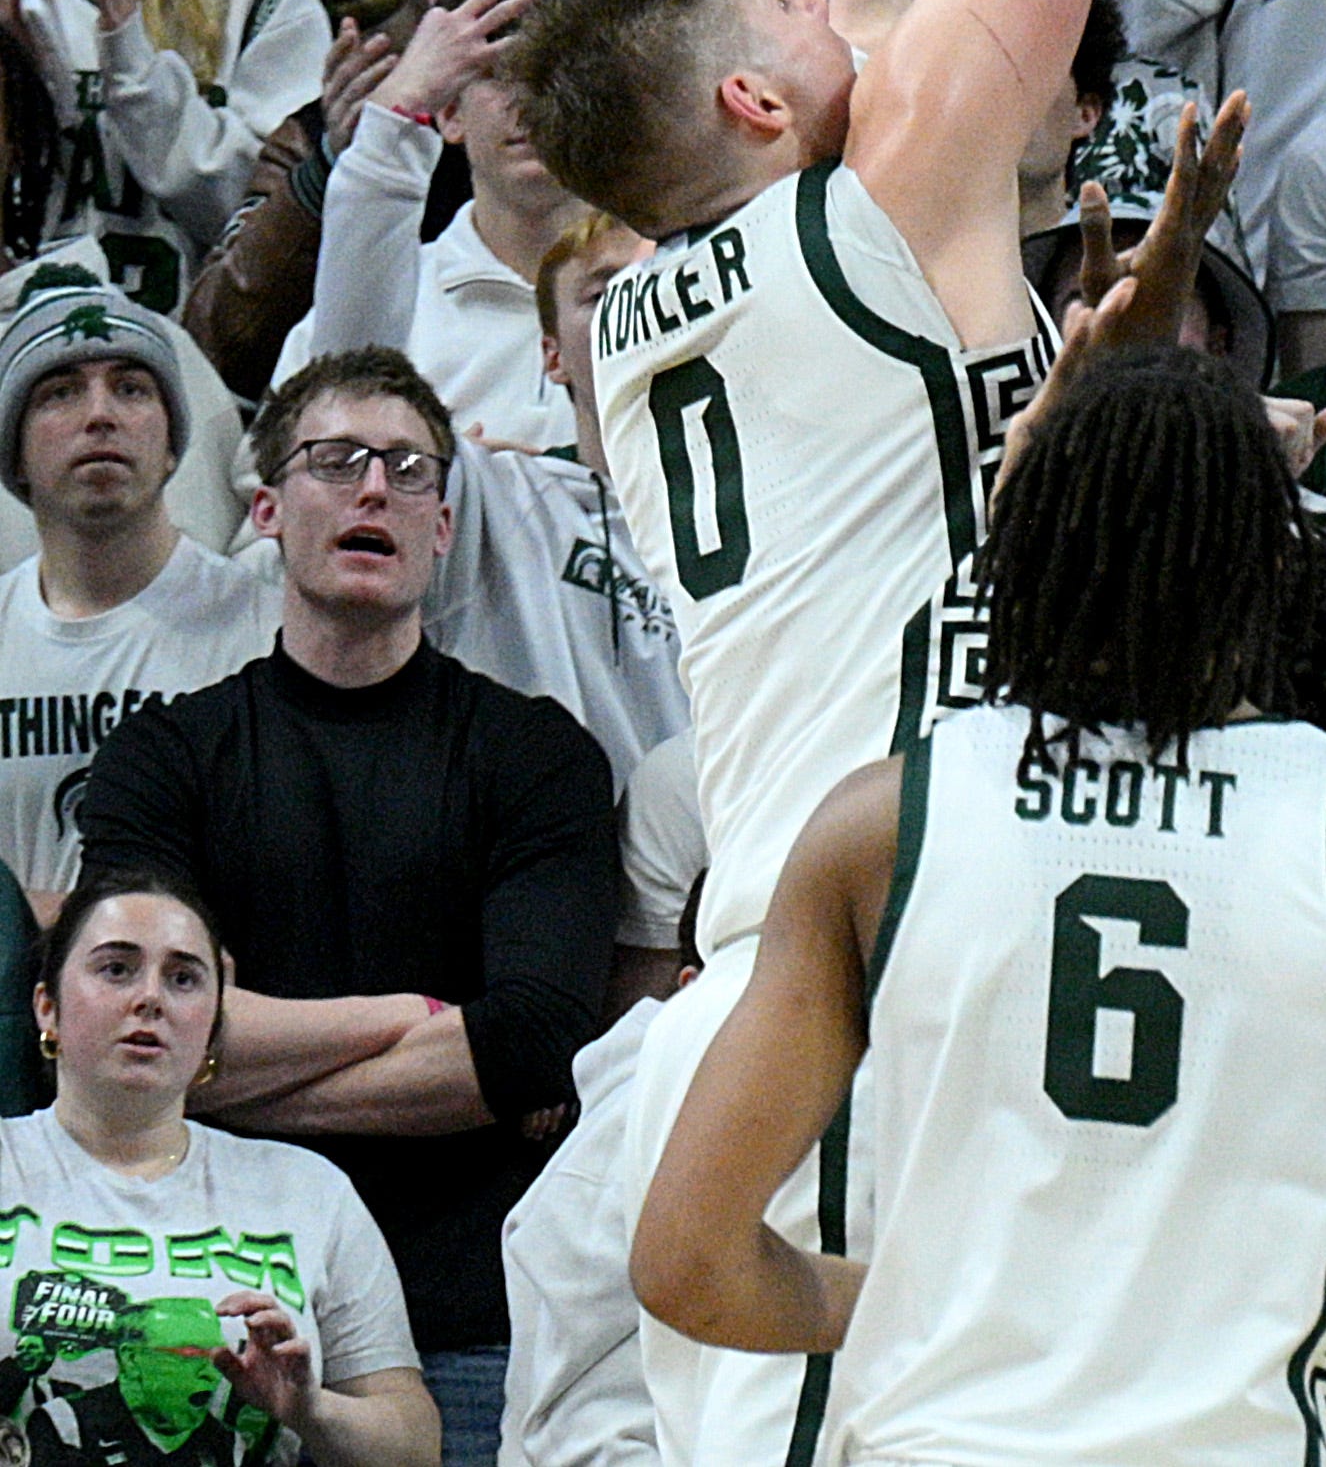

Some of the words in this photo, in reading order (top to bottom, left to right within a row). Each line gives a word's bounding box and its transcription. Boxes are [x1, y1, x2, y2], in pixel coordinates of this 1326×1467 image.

[599, 226, 753, 361] KOHLER
[648, 355, 752, 603] 0
[1015, 758, 1238, 838] SCOTT
[1042, 872, 1191, 1128] 6
[34, 1281, 111, 1310] FINAL
[38, 1301, 116, 1331] FOUR
